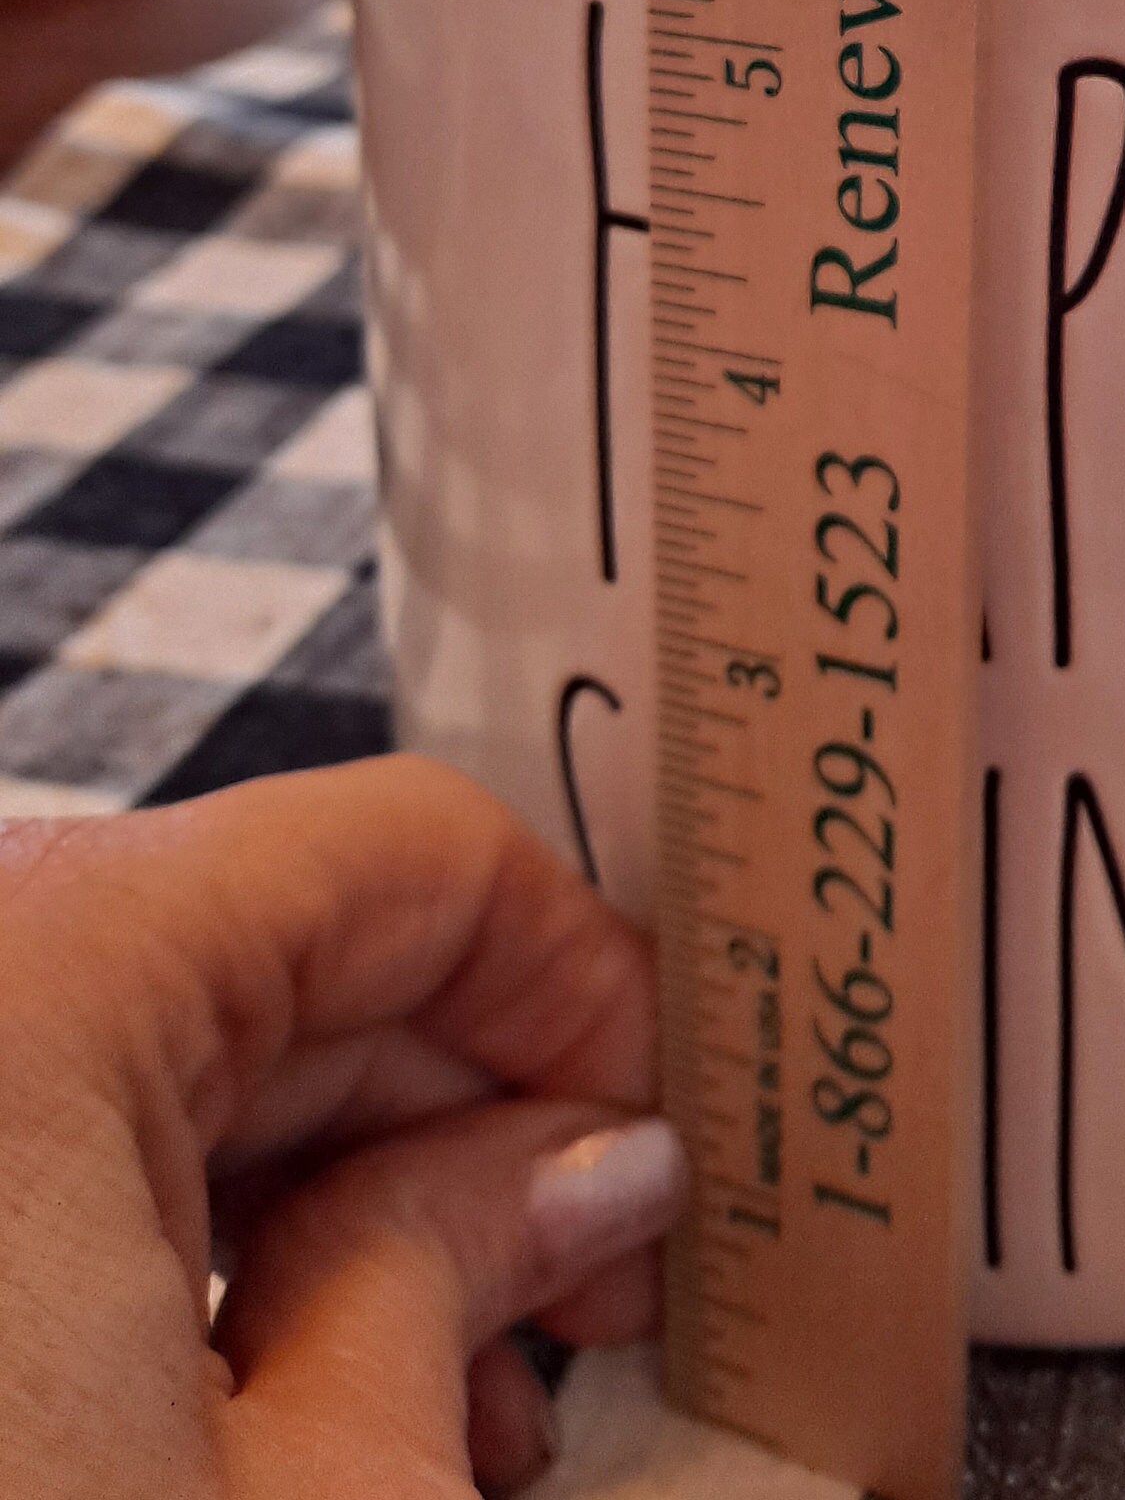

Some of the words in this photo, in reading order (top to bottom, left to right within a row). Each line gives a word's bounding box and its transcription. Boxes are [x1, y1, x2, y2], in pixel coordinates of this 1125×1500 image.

[724, 58, 782, 97] 5
[723, 369, 781, 405] 4
[725, 660, 782, 700] 3
[812, 452, 900, 1226] 1-866-229-1523
[727, 936, 780, 981] 2
[727, 1205, 781, 1239] 1
